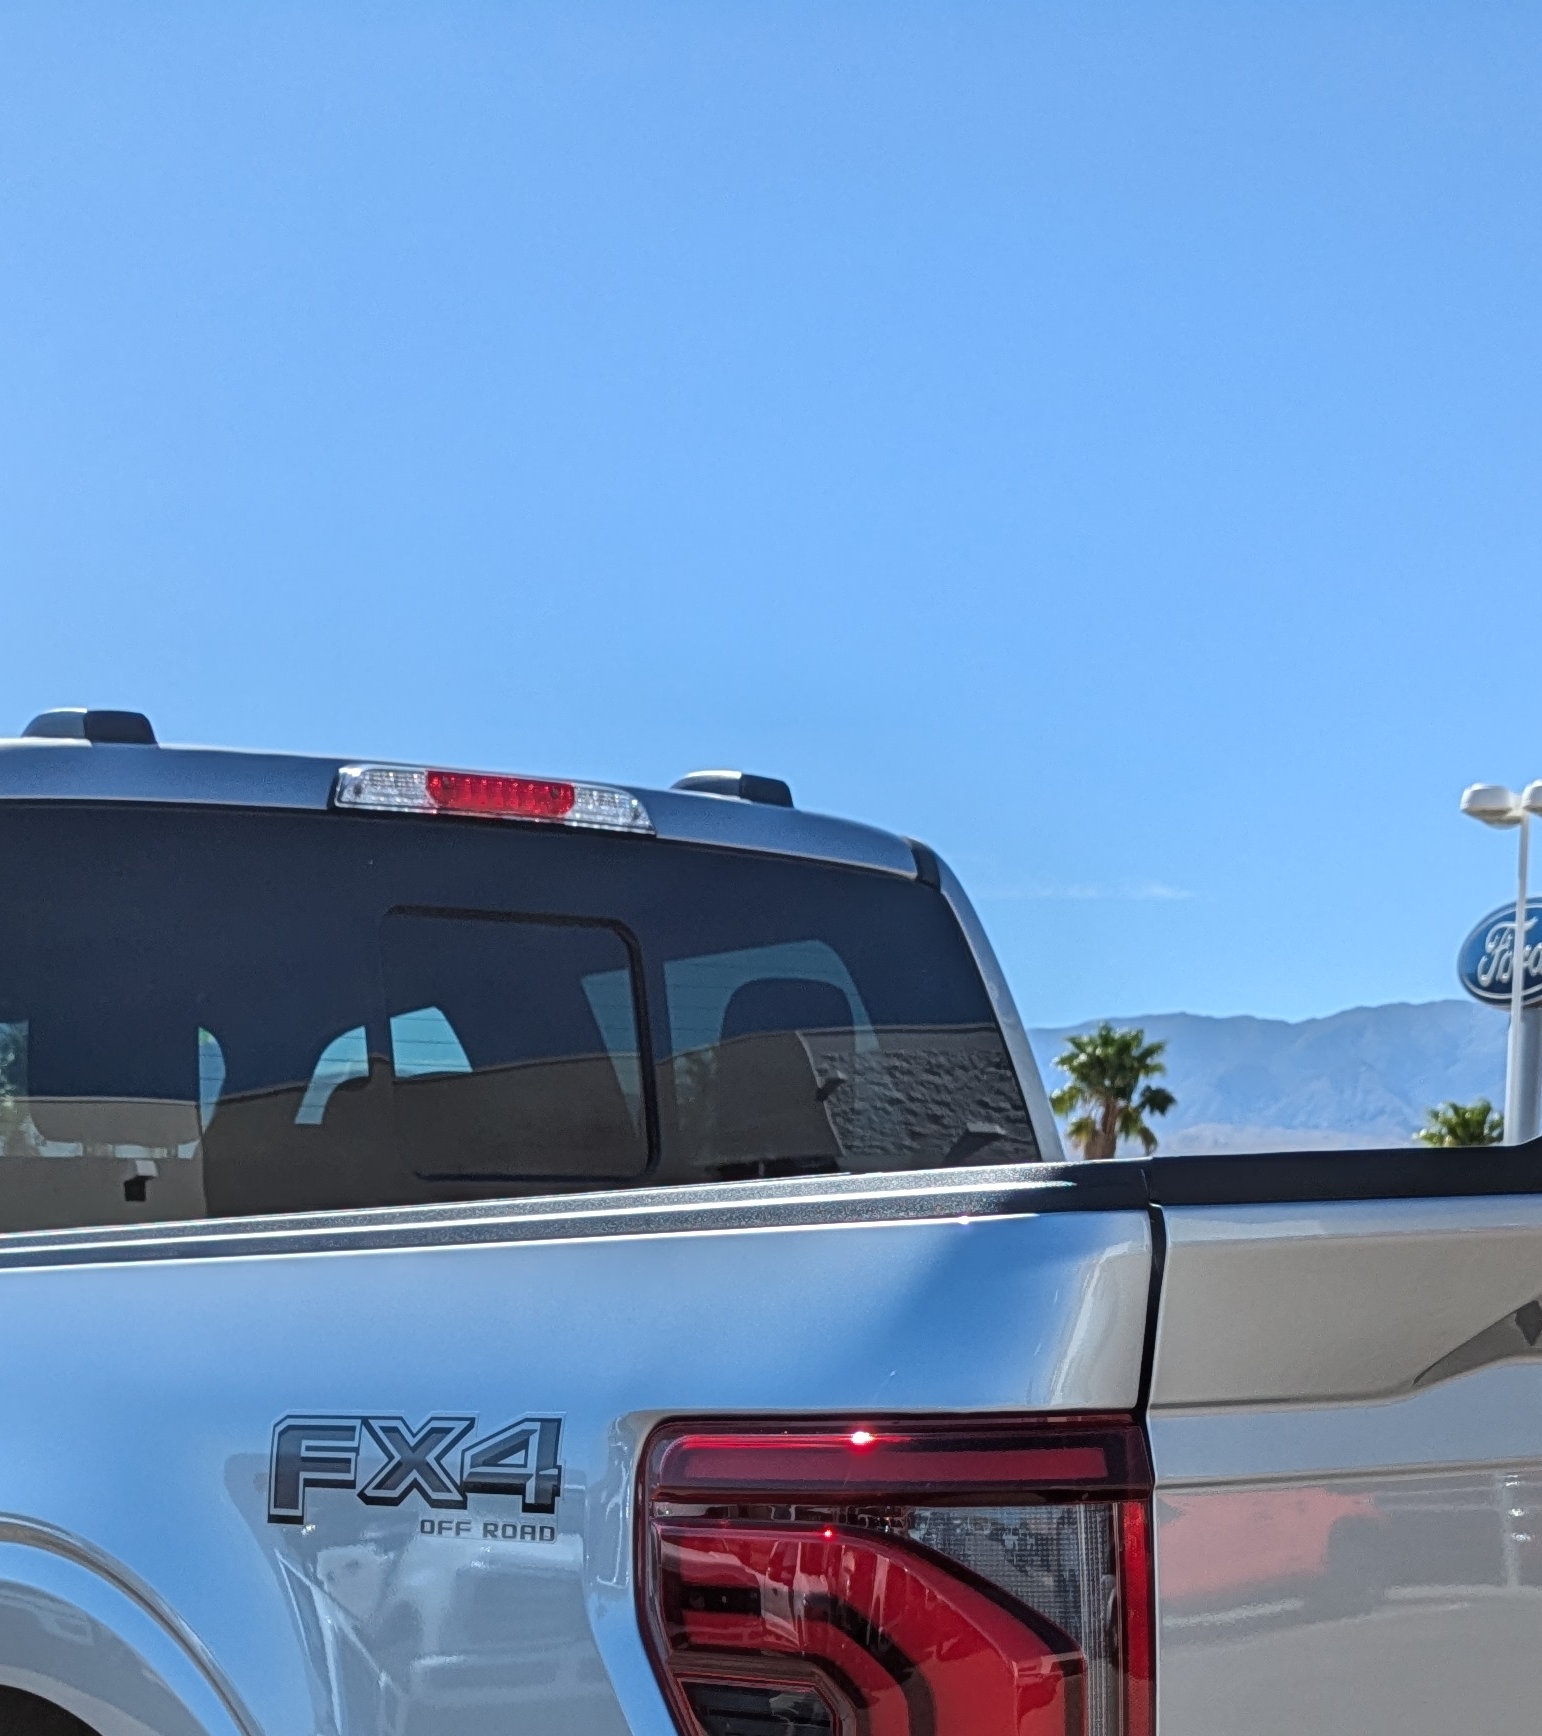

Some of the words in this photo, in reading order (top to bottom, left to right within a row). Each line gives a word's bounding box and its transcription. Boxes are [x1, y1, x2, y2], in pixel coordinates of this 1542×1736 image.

[267, 1414, 563, 1525] FX4
[420, 1518, 472, 1536] OFF
[482, 1522, 555, 1542] ROAD
